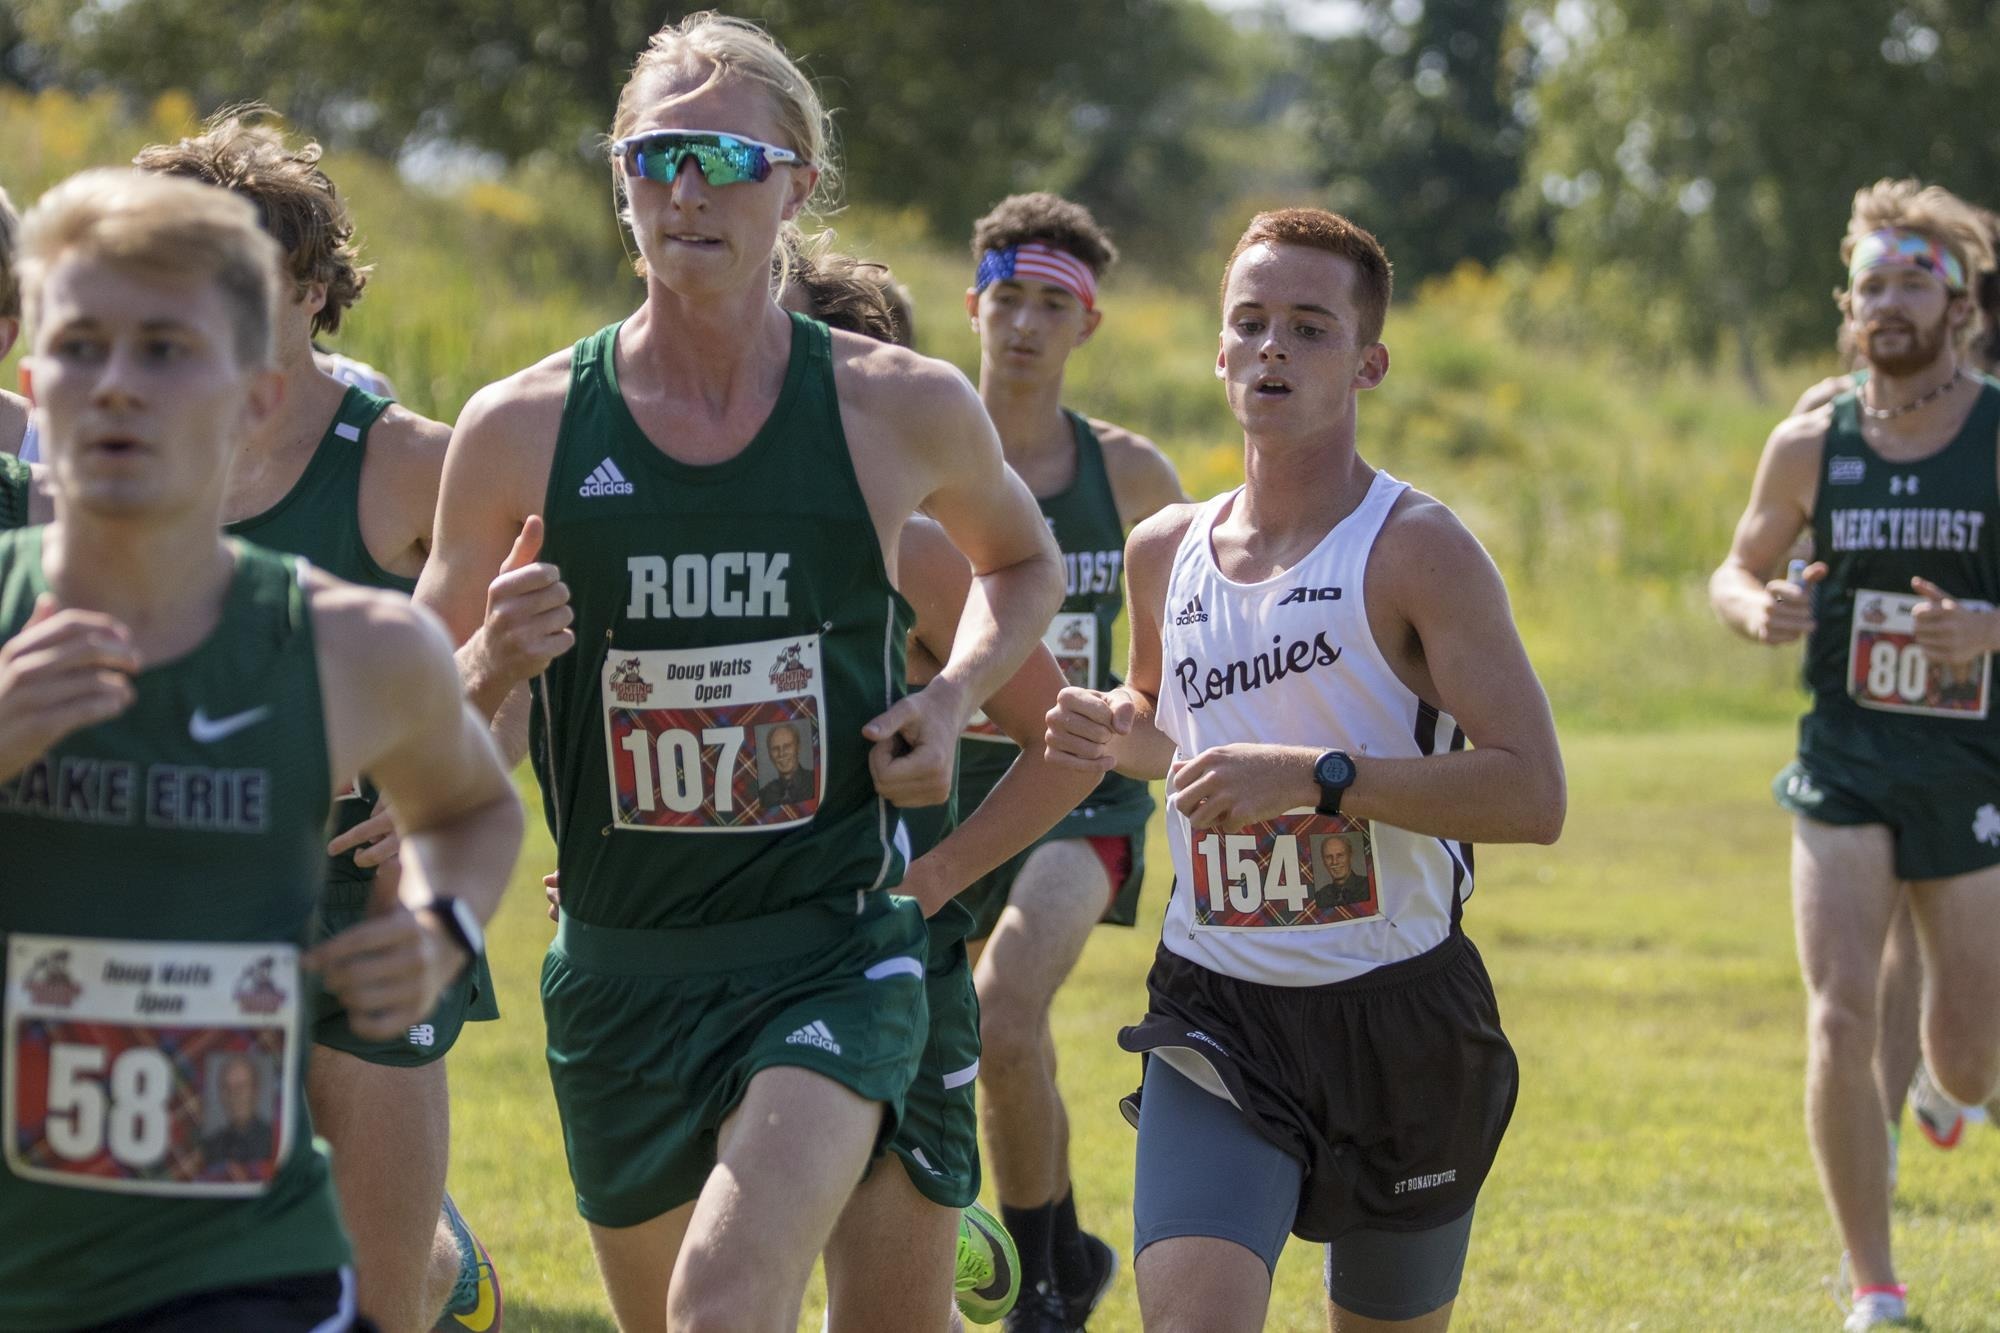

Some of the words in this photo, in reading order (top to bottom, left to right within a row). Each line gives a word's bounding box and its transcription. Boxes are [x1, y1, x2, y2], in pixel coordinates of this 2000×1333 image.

[579, 480, 633, 497] adidas
[1831, 508, 1985, 552] MERCYHURST
[626, 552, 790, 619] ROCK
[1277, 587, 1342, 606] A10
[1176, 612, 1209, 626] adidas
[667, 663, 704, 681] Doug
[709, 658, 752, 677] Watts
[1175, 631, 1342, 713] Bonnies
[1867, 640, 1928, 702] 80
[694, 684, 732, 703] Open
[621, 725, 745, 813] 107
[0, 756, 136, 826] AKE
[146, 763, 270, 834] ERIE
[1198, 834, 1309, 914] 154
[785, 1034, 841, 1056] adidas
[46, 1043, 174, 1168] 58
[1394, 1181, 1406, 1194] ST
[1407, 1169, 1456, 1191] BONAVENTURE
